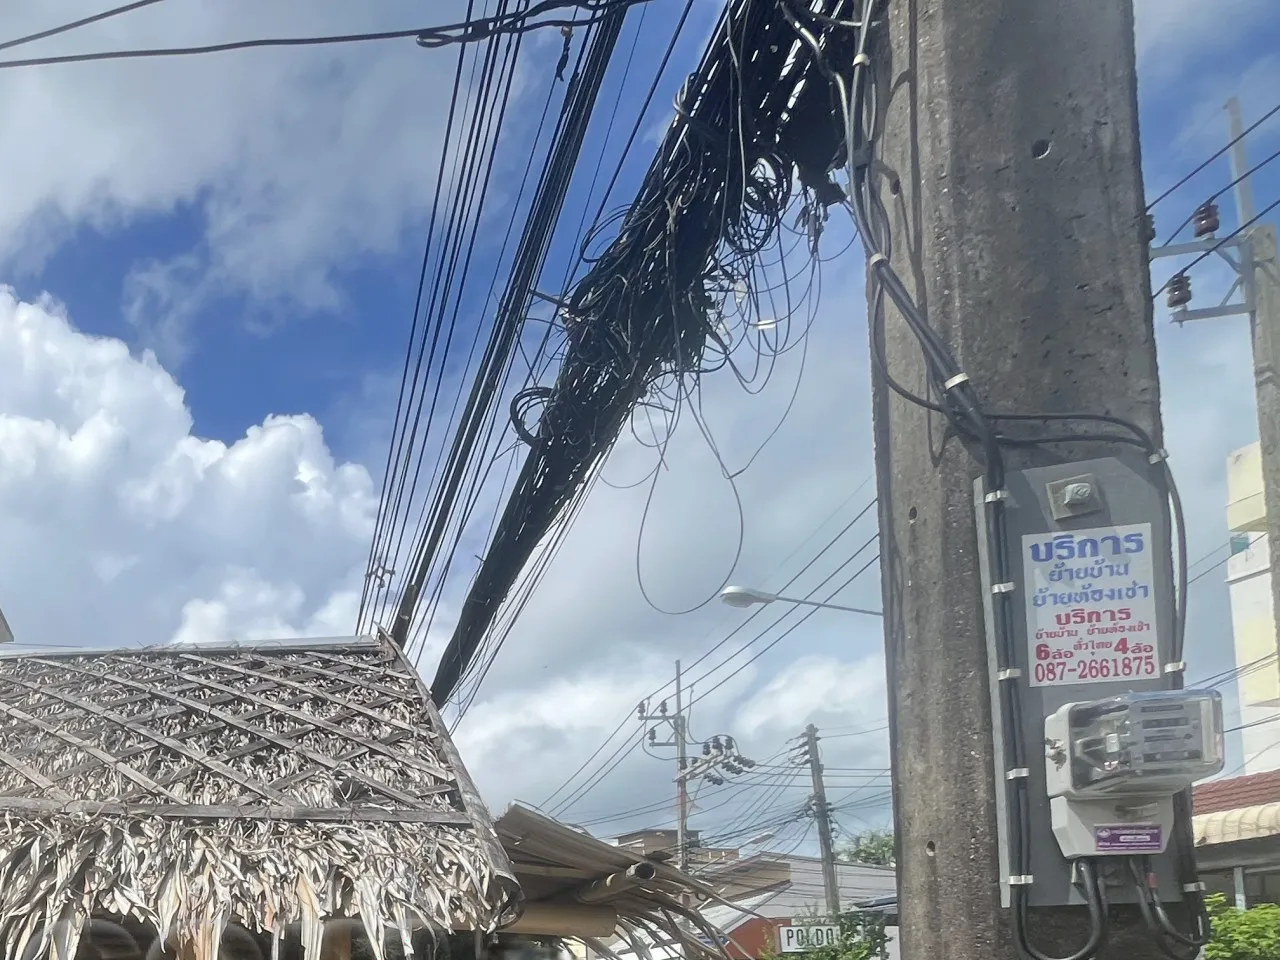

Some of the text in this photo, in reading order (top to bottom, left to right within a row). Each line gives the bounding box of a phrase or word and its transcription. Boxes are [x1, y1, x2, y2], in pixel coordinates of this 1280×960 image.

[1029, 532, 1145, 563] บริการ
[1048, 558, 1129, 582] ย้ายบ้าน
[1032, 580, 1149, 607] ย้ายห้องเช่า
[1054, 608, 1132, 627] บริการ
[1034, 655, 1156, 682] 087-2661875
